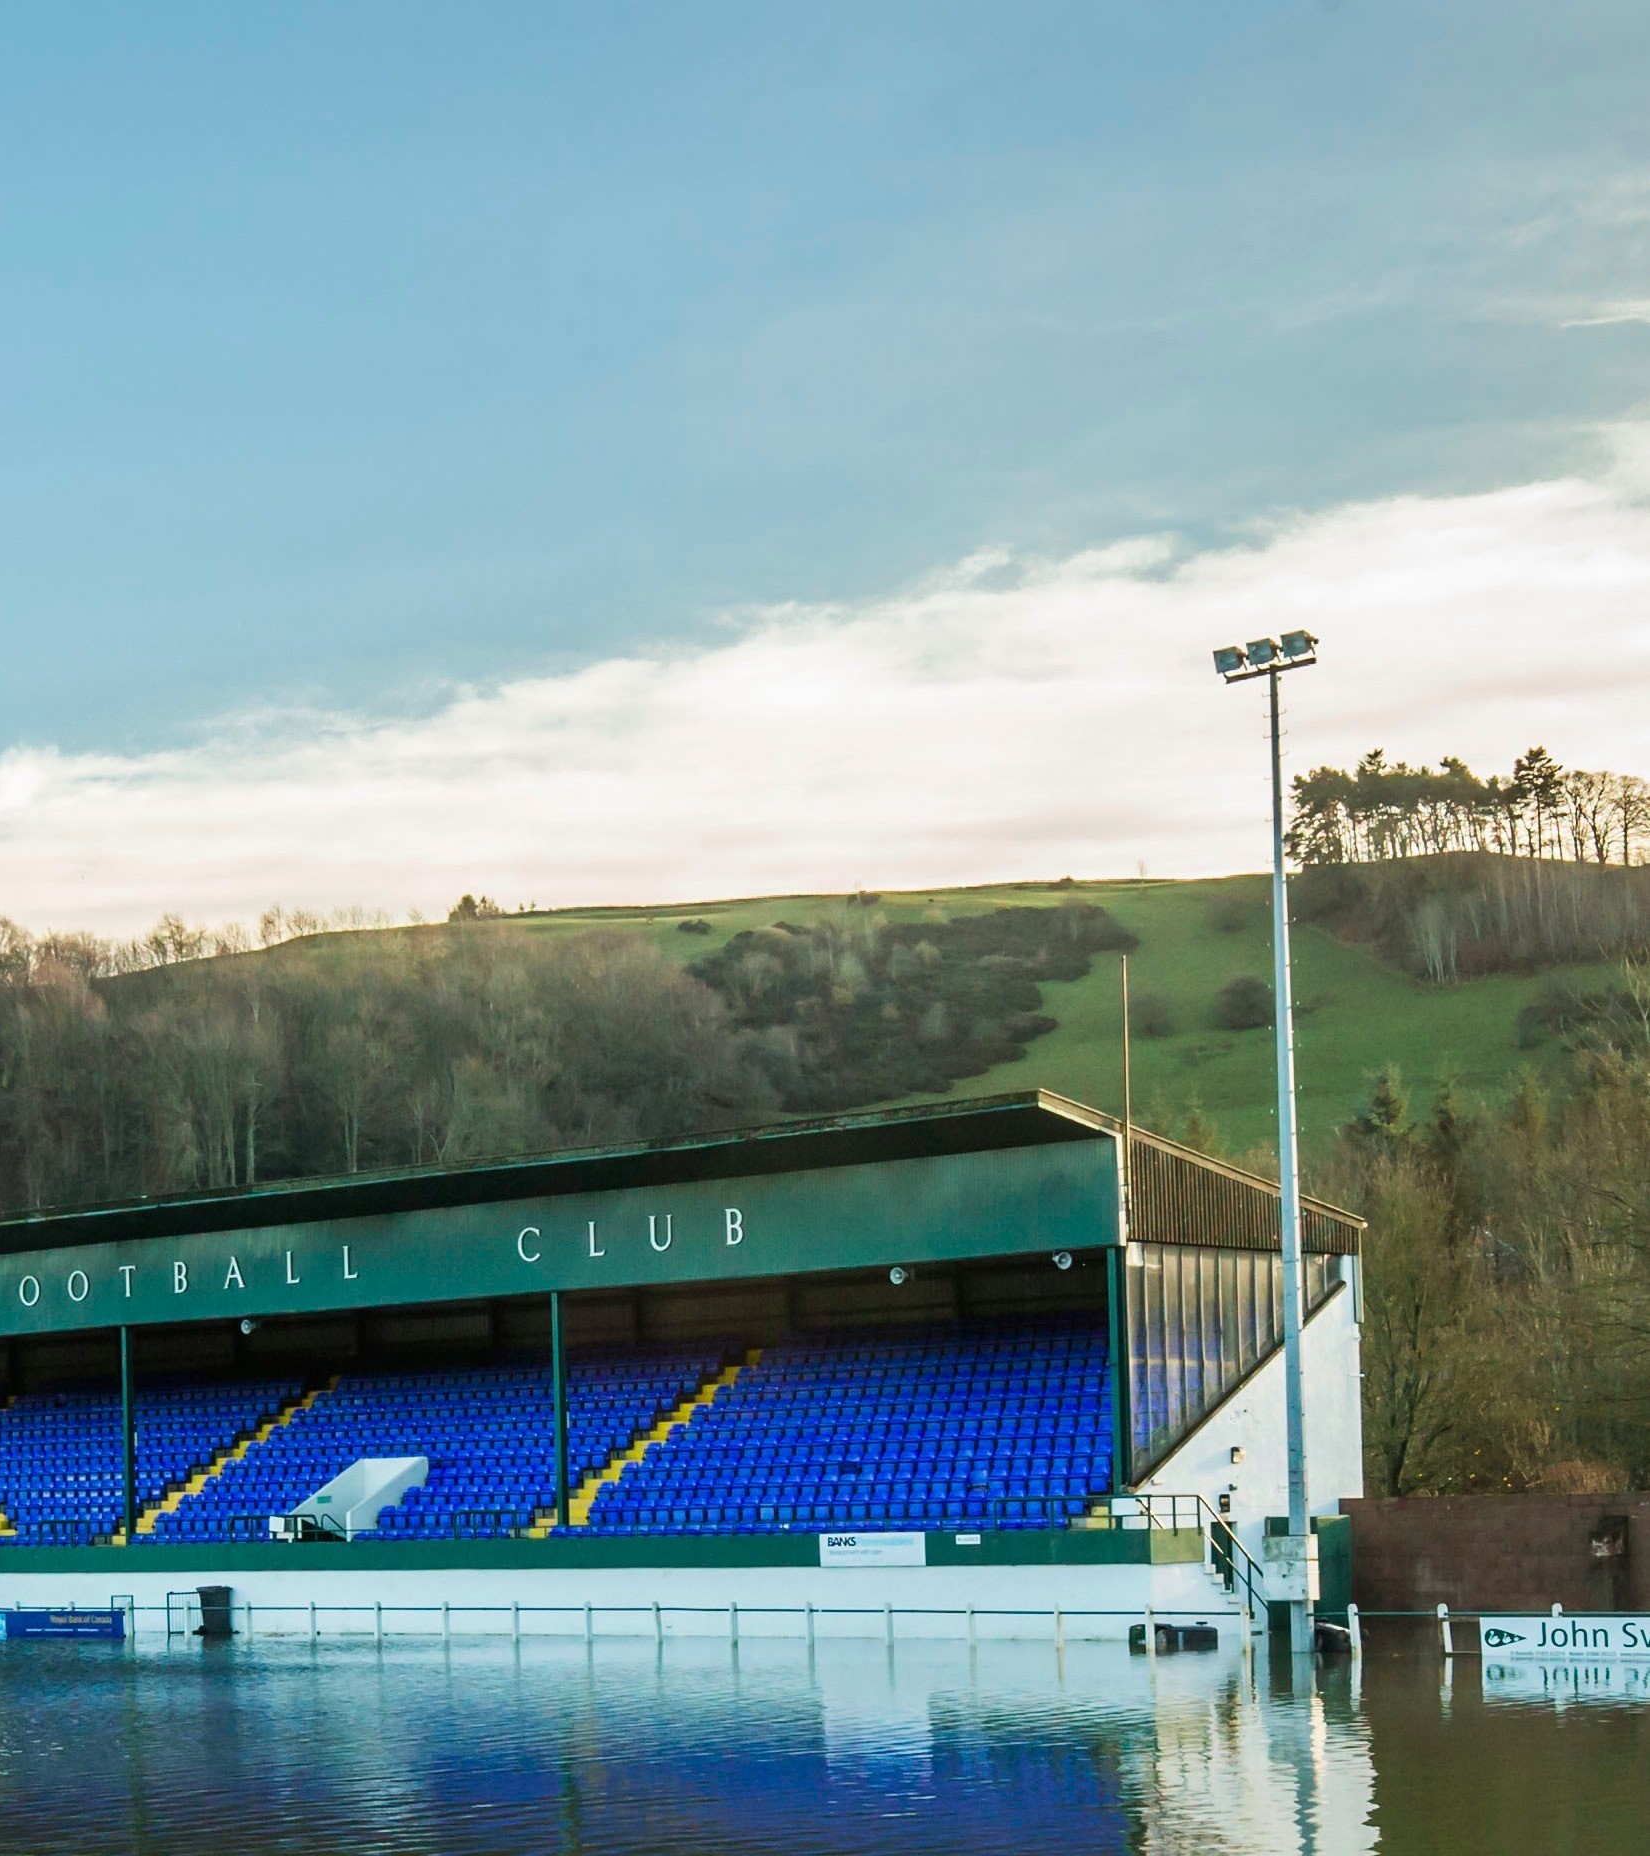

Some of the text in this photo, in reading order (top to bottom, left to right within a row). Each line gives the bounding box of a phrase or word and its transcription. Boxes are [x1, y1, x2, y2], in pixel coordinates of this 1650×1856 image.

[517, 1208, 744, 1262] CLUB
[827, 1536, 856, 1547] BANKS
[1537, 1620, 1609, 1647] John
